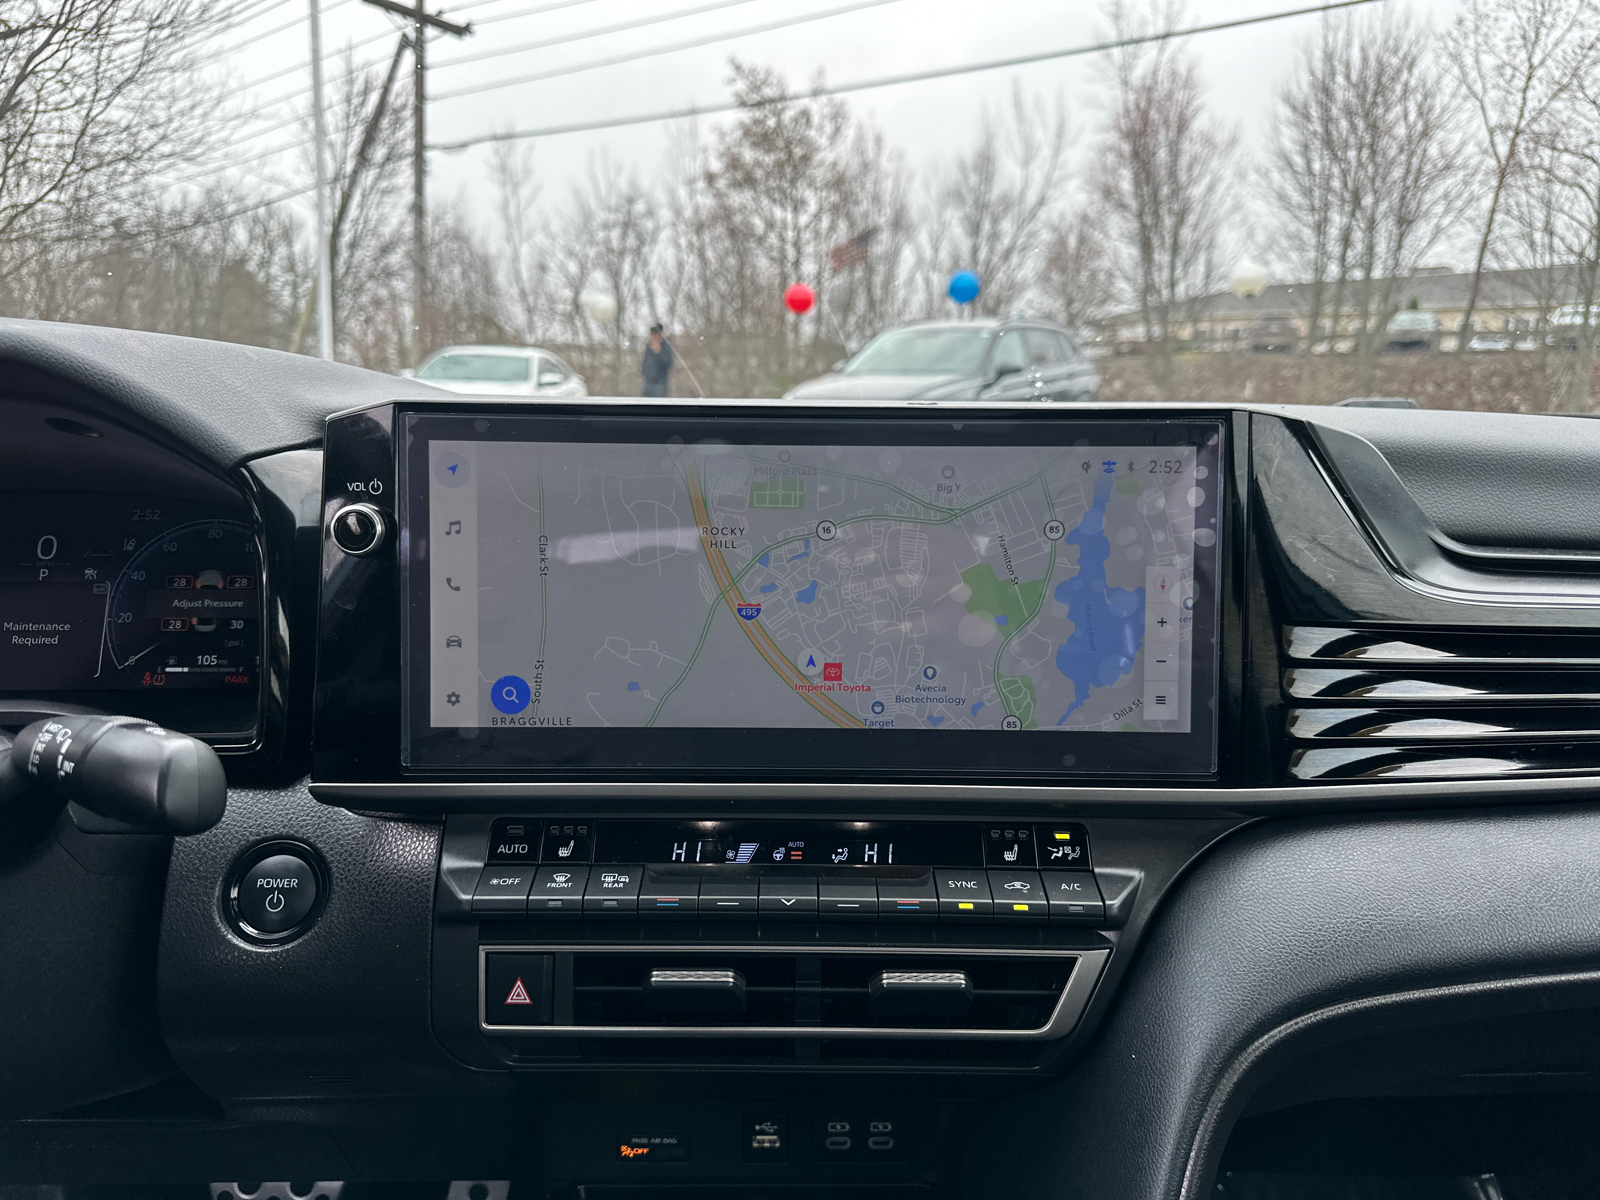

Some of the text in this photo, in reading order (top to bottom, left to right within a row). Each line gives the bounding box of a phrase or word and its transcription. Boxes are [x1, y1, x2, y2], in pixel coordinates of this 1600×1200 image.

[753, 466, 817, 476] Milford Plaza
[1149, 460, 1182, 473] 2:52
[346, 482, 366, 491] VOL
[936, 483, 961, 493] Big Y
[132, 509, 161, 520] 2:52
[208, 529, 223, 539] 80
[702, 526, 746, 536] ROCKY
[822, 526, 831, 535] 16
[1049, 526, 1060, 534] 85
[37, 535, 58, 560] 0
[163, 542, 178, 552] 60
[710, 540, 737, 549] HILL
[538, 534, 549, 577] Clark St
[997, 534, 1020, 587] Hamilton St
[39, 568, 49, 581] P
[131, 571, 146, 581] 40
[173, 578, 187, 587] 28
[235, 578, 248, 587] 28
[172, 599, 244, 609] Adjust Pressure
[740, 608, 757, 616] 495
[118, 613, 133, 623] 20
[3, 622, 71, 632] Maintenance
[169, 620, 182, 629] 28
[230, 620, 244, 629] 30
[11, 635, 59, 646] Required
[196, 655, 218, 665] 105
[225, 675, 249, 684] PARK
[531, 658, 545, 705] South St
[794, 683, 871, 694] Imperial Toyota
[915, 683, 947, 693] Avecia
[895, 694, 967, 706] Biotechnology
[1112, 698, 1144, 721] Dilla St
[491, 717, 573, 726] BRAGGVILLE
[863, 719, 895, 728] Target
[1006, 721, 1017, 729] 85
[497, 844, 528, 853] AUTO
[257, 878, 298, 888] POWER
[499, 877, 521, 885] OFF
[948, 880, 977, 889] SYNC
[1060, 882, 1082, 891] A/C
[633, 1147, 650, 1155] OFF
